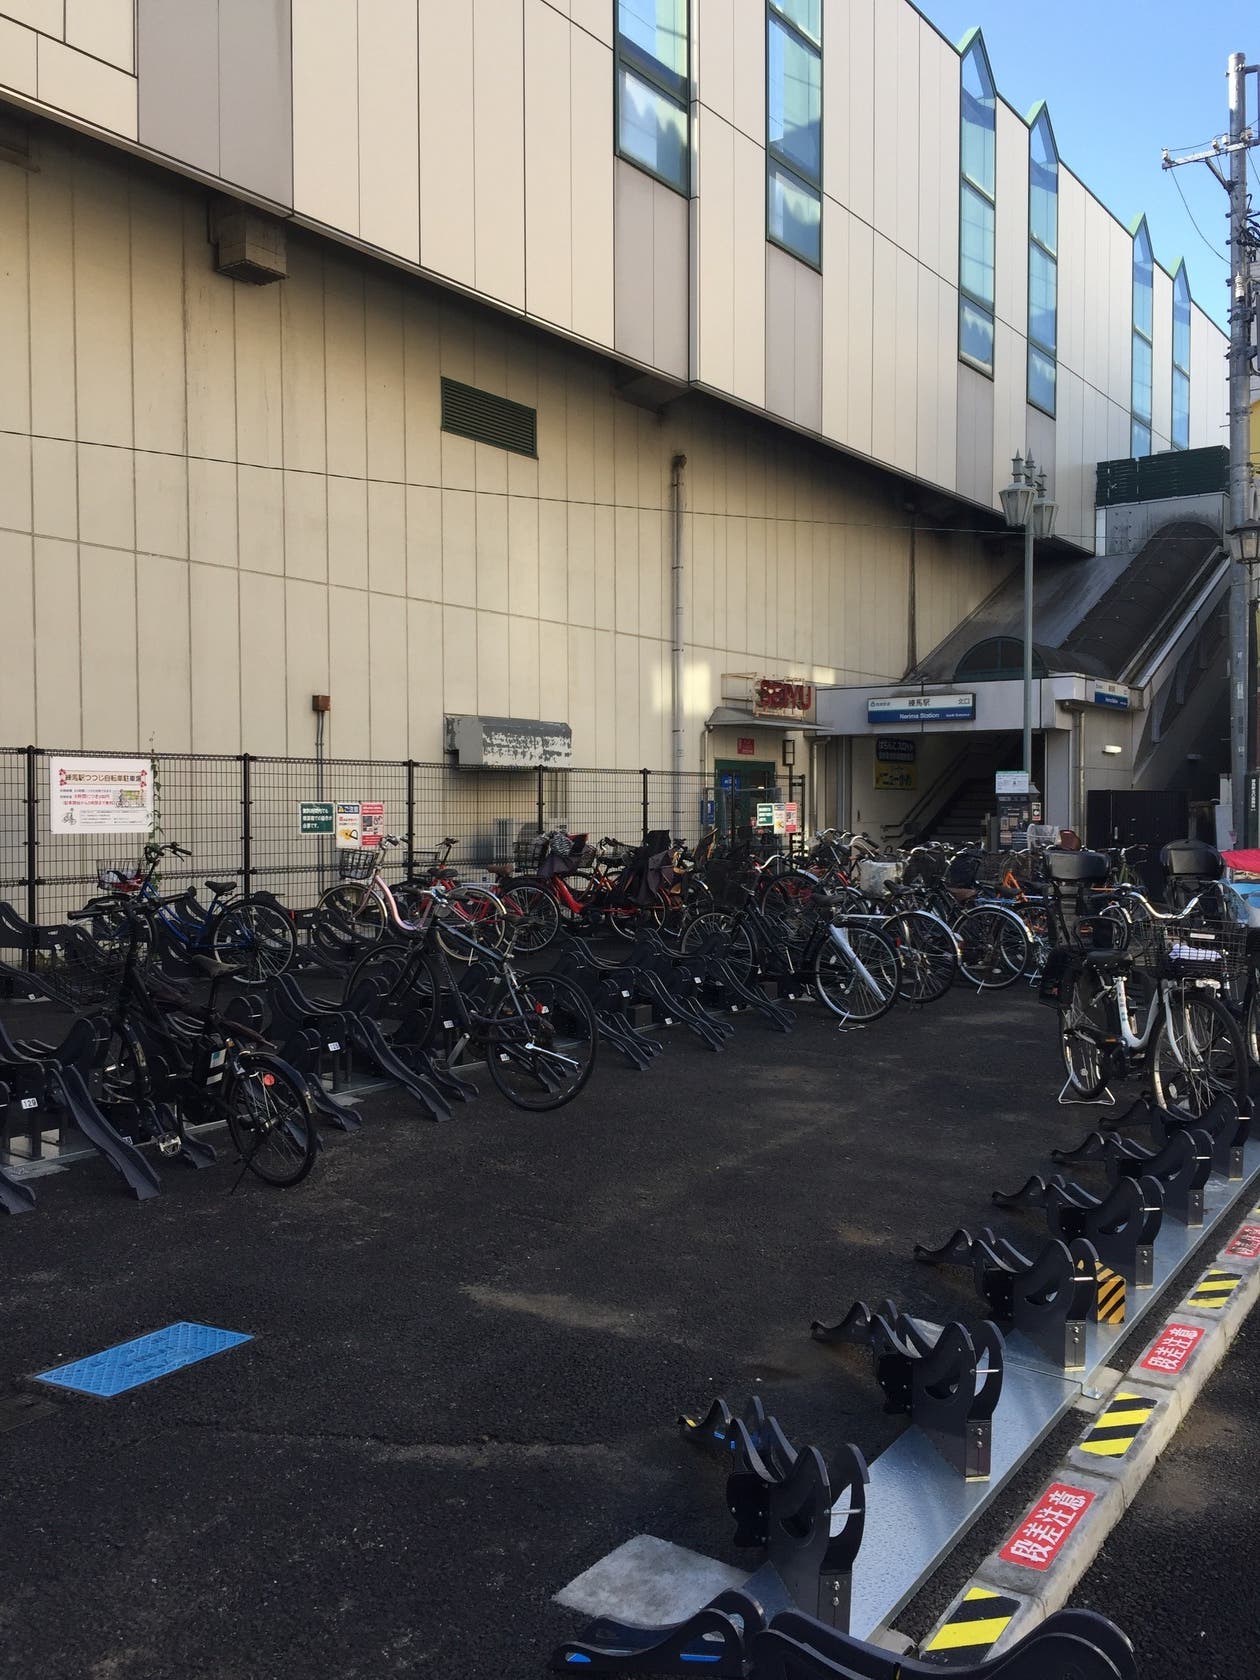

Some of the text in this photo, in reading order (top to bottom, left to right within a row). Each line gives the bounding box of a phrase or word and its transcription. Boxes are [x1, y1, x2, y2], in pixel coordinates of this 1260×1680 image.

[908, 698, 930, 706] 練馬駅
[23, 1099, 37, 1108] 129
[1147, 1328, 1199, 1370] 段差注意
[1010, 1490, 1087, 1562] 段差注意
